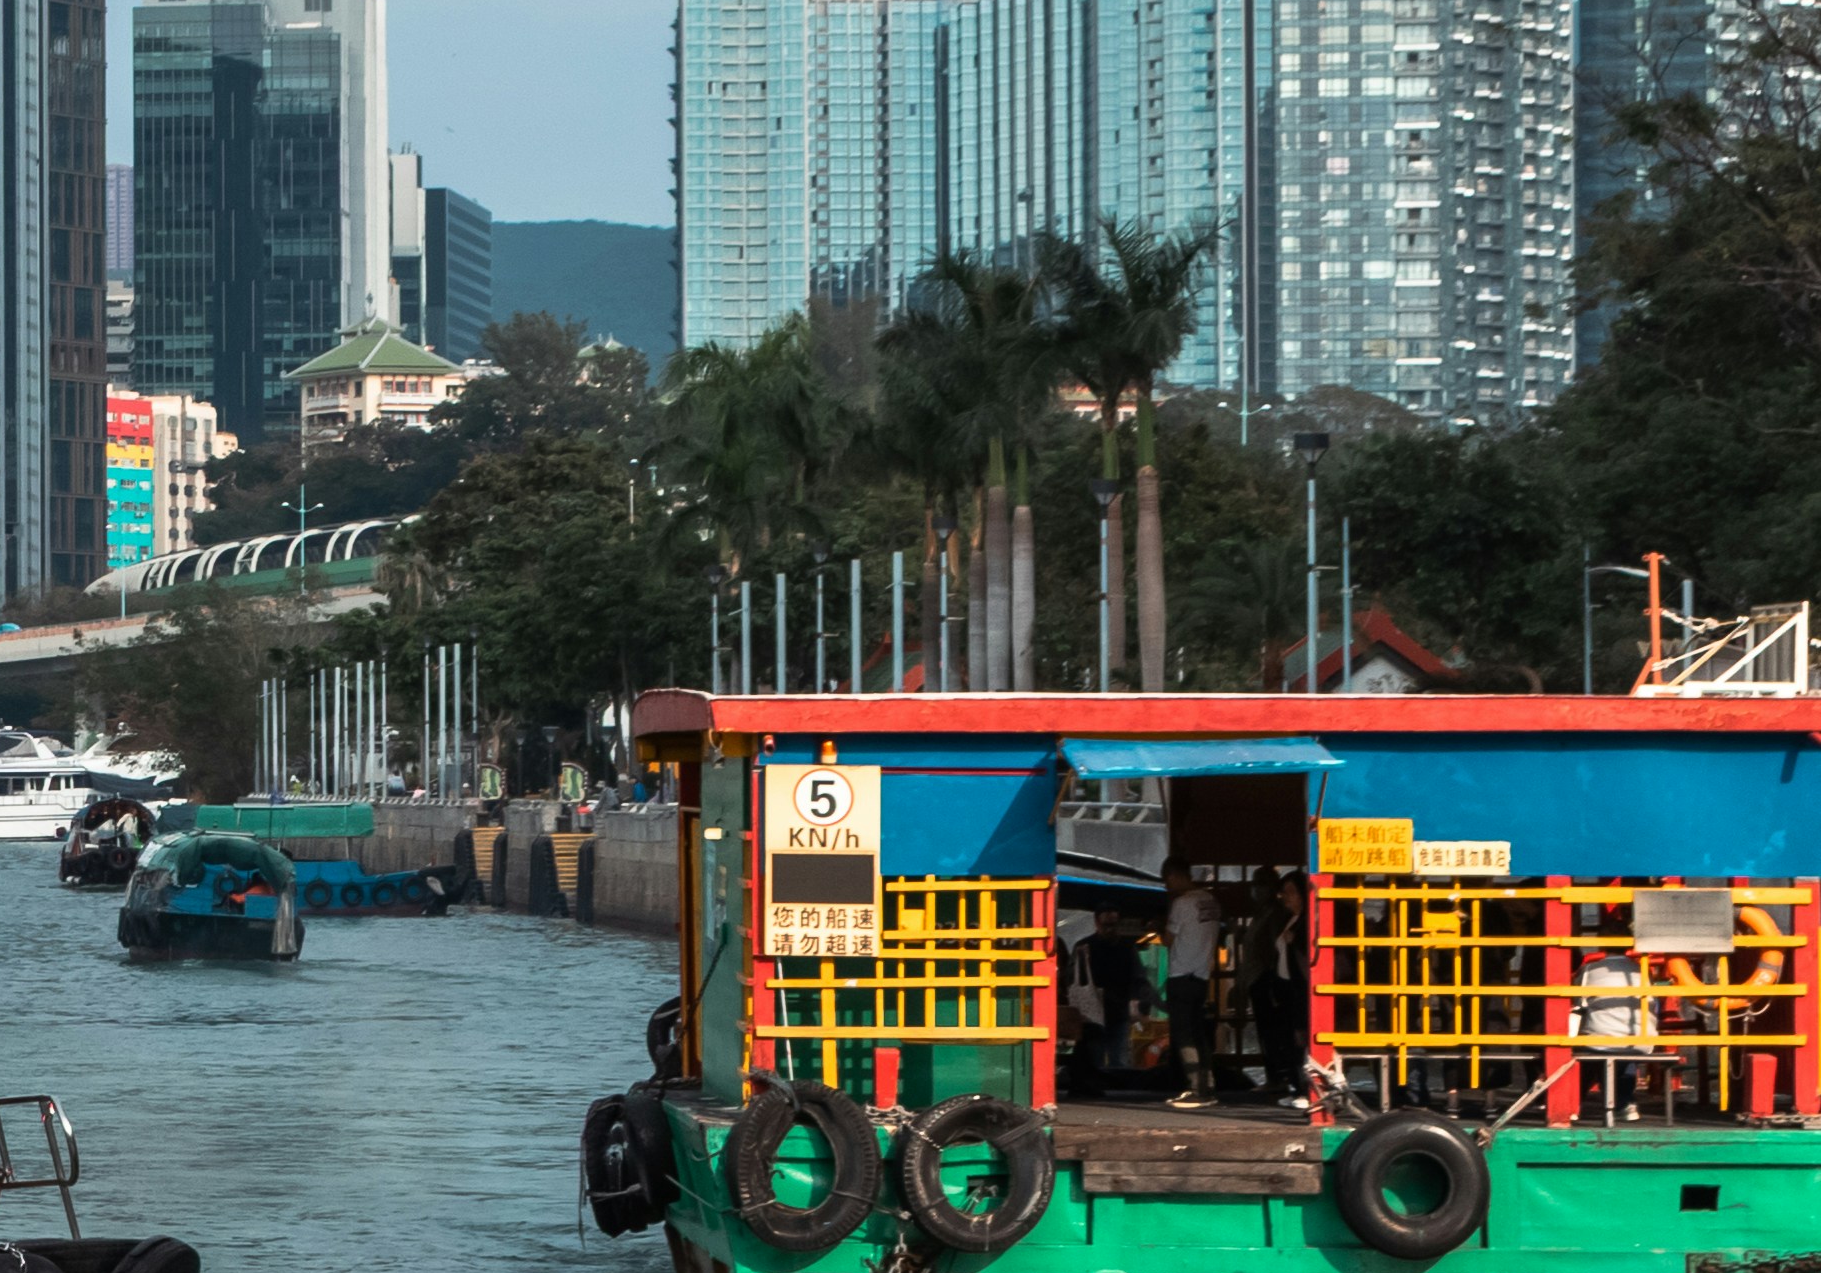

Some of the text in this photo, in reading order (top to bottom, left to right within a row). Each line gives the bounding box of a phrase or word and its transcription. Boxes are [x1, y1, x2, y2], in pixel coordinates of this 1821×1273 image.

[811, 780, 837, 818] 5
[789, 828, 860, 850] KN/h
[1324, 848, 1407, 866] 請勿跳船
[773, 907, 874, 929] 您的船速
[773, 933, 874, 956] 请勿超速
